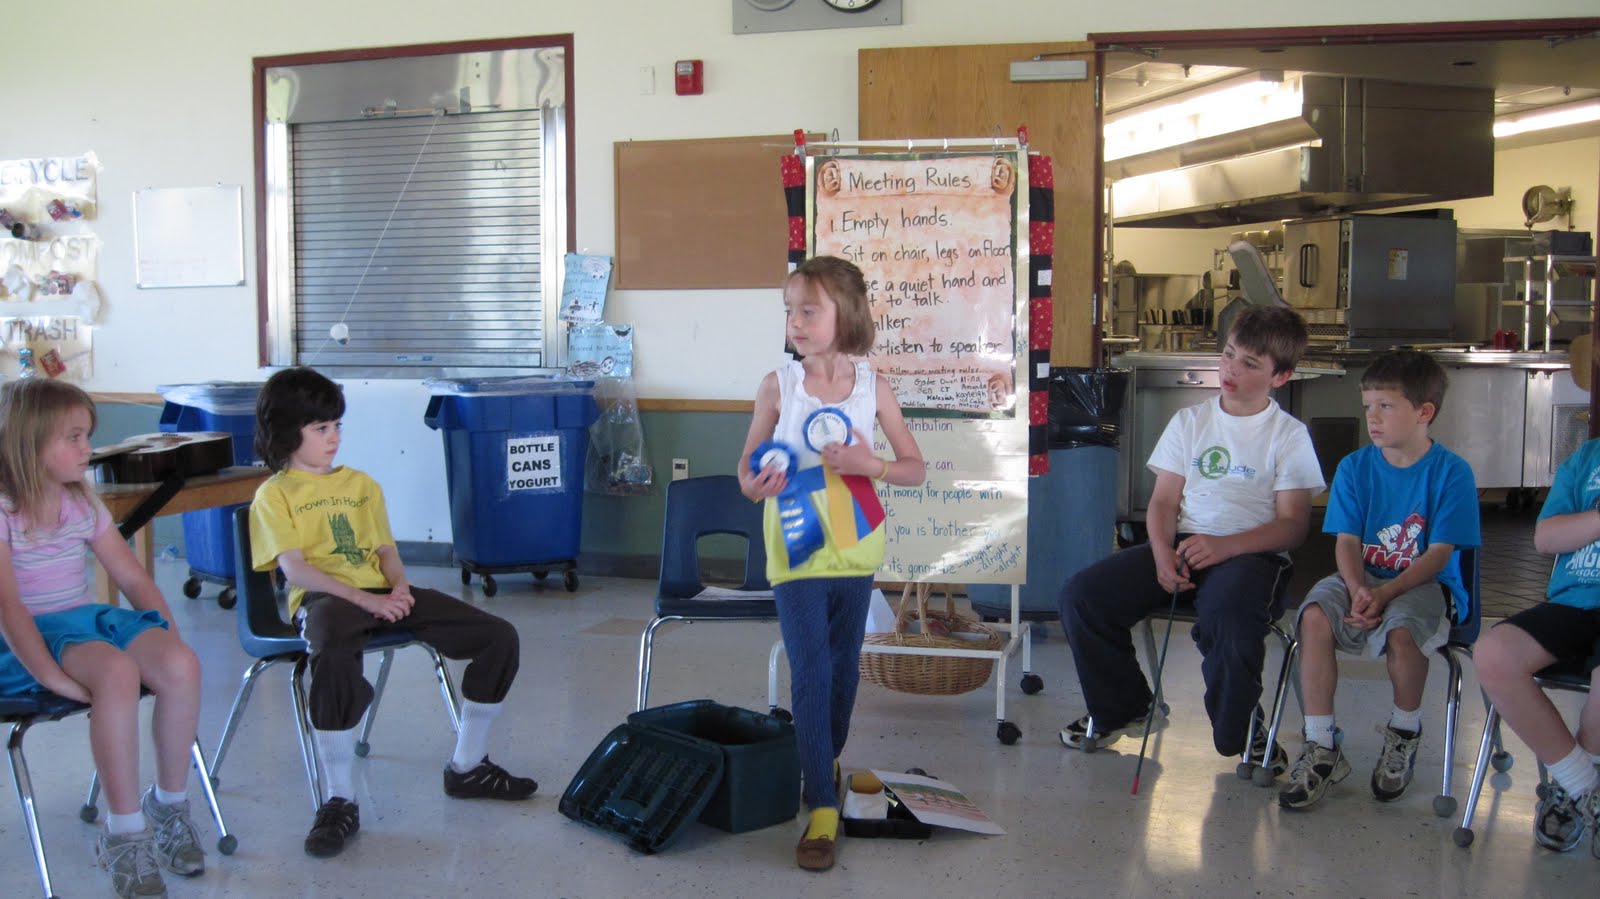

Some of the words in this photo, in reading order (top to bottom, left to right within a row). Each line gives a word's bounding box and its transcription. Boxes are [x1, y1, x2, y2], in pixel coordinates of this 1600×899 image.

[849, 169, 916, 192] Meeting
[925, 167, 972, 188] Rules
[842, 211, 889, 237] Empty
[842, 245, 864, 262] Sit
[871, 250, 888, 262] on
[894, 246, 929, 263] chair,
[935, 241, 959, 267] legs
[968, 247, 982, 258] on
[885, 280, 894, 291] a
[900, 273, 933, 299] quiet
[941, 269, 976, 289] hand
[982, 266, 1007, 286] and
[887, 294, 903, 307] to
[5, 317, 78, 342] TRASH
[929, 337, 944, 353] to
[905, 417, 953, 432] ntribution
[509, 443, 555, 455] BOTTLE
[511, 459, 552, 473] CANS
[509, 476, 559, 489] YOGURT
[894, 489, 923, 504] money
[926, 481, 939, 498] for
[943, 484, 972, 504] people
[895, 525, 911, 544] you
[916, 523, 926, 537] is
